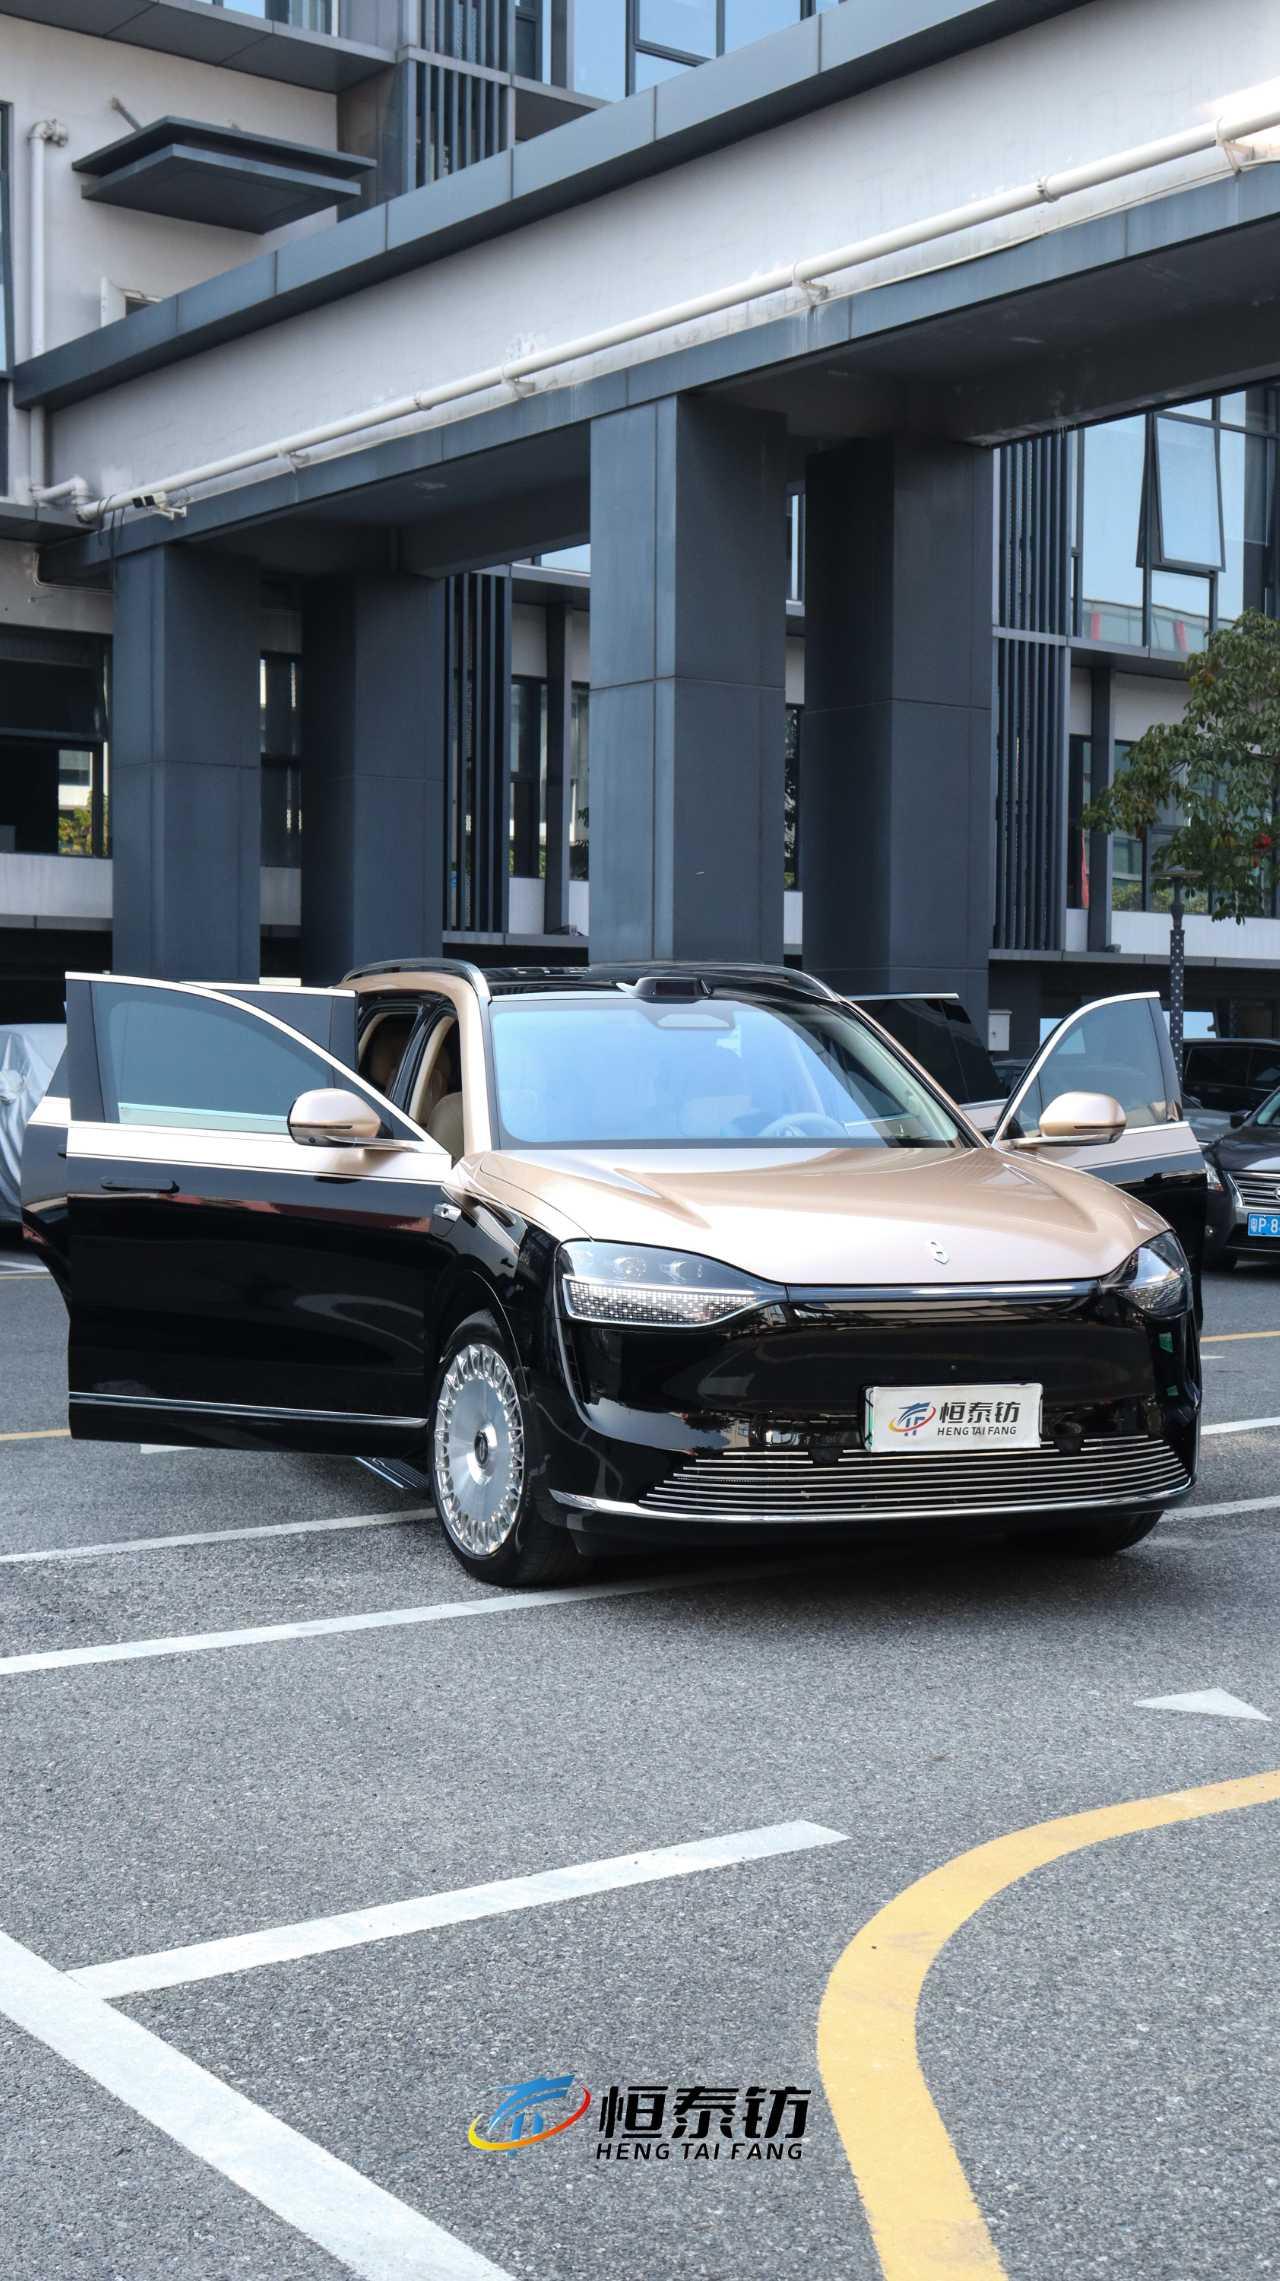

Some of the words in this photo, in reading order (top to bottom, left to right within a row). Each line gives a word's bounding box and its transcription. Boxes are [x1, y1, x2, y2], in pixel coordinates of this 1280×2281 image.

[940, 1401, 1021, 1423] 恒泰钫
[937, 1427, 969, 1436] HENG
[971, 1426, 986, 1436] TAI
[987, 1426, 1017, 1435] FANG
